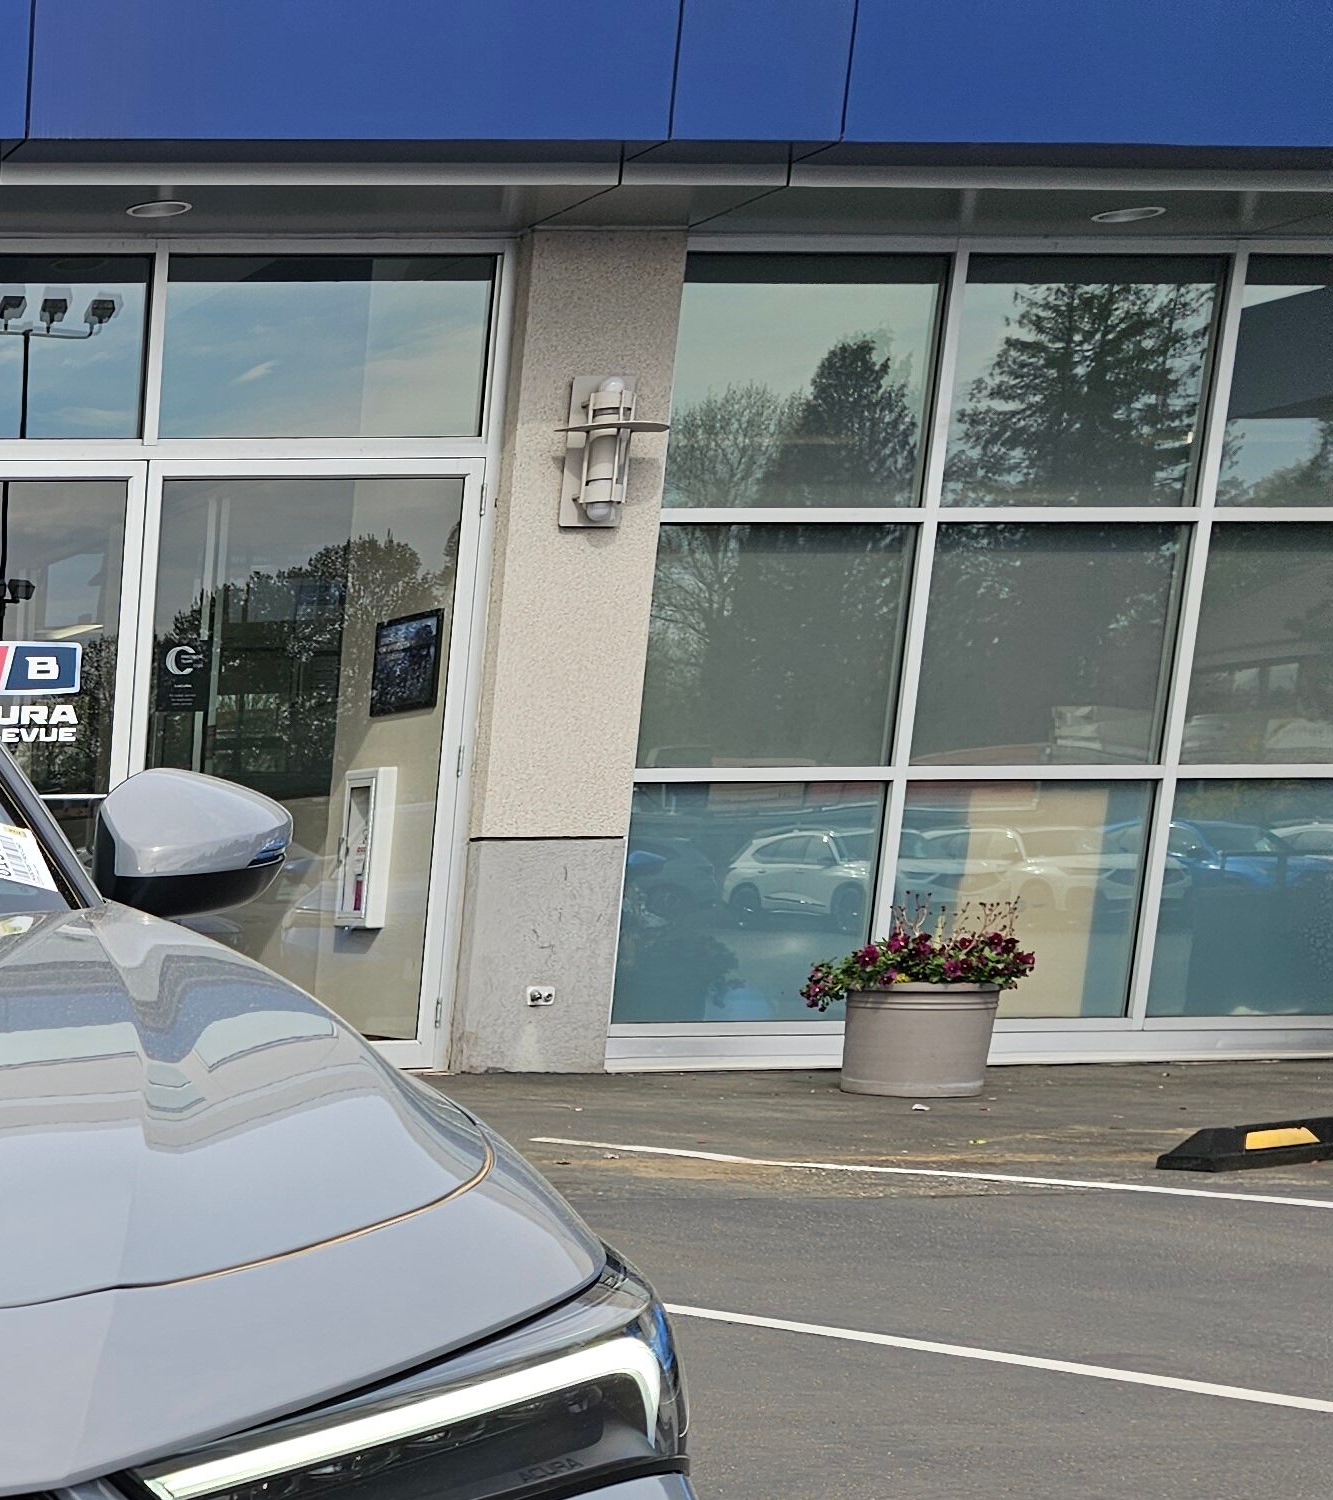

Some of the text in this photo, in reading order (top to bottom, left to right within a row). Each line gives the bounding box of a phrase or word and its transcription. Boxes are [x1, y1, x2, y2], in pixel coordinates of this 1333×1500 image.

[24, 655, 60, 680] B
[1, 727, 77, 743] EVUE
[518, 1457, 584, 1484] ACURA
